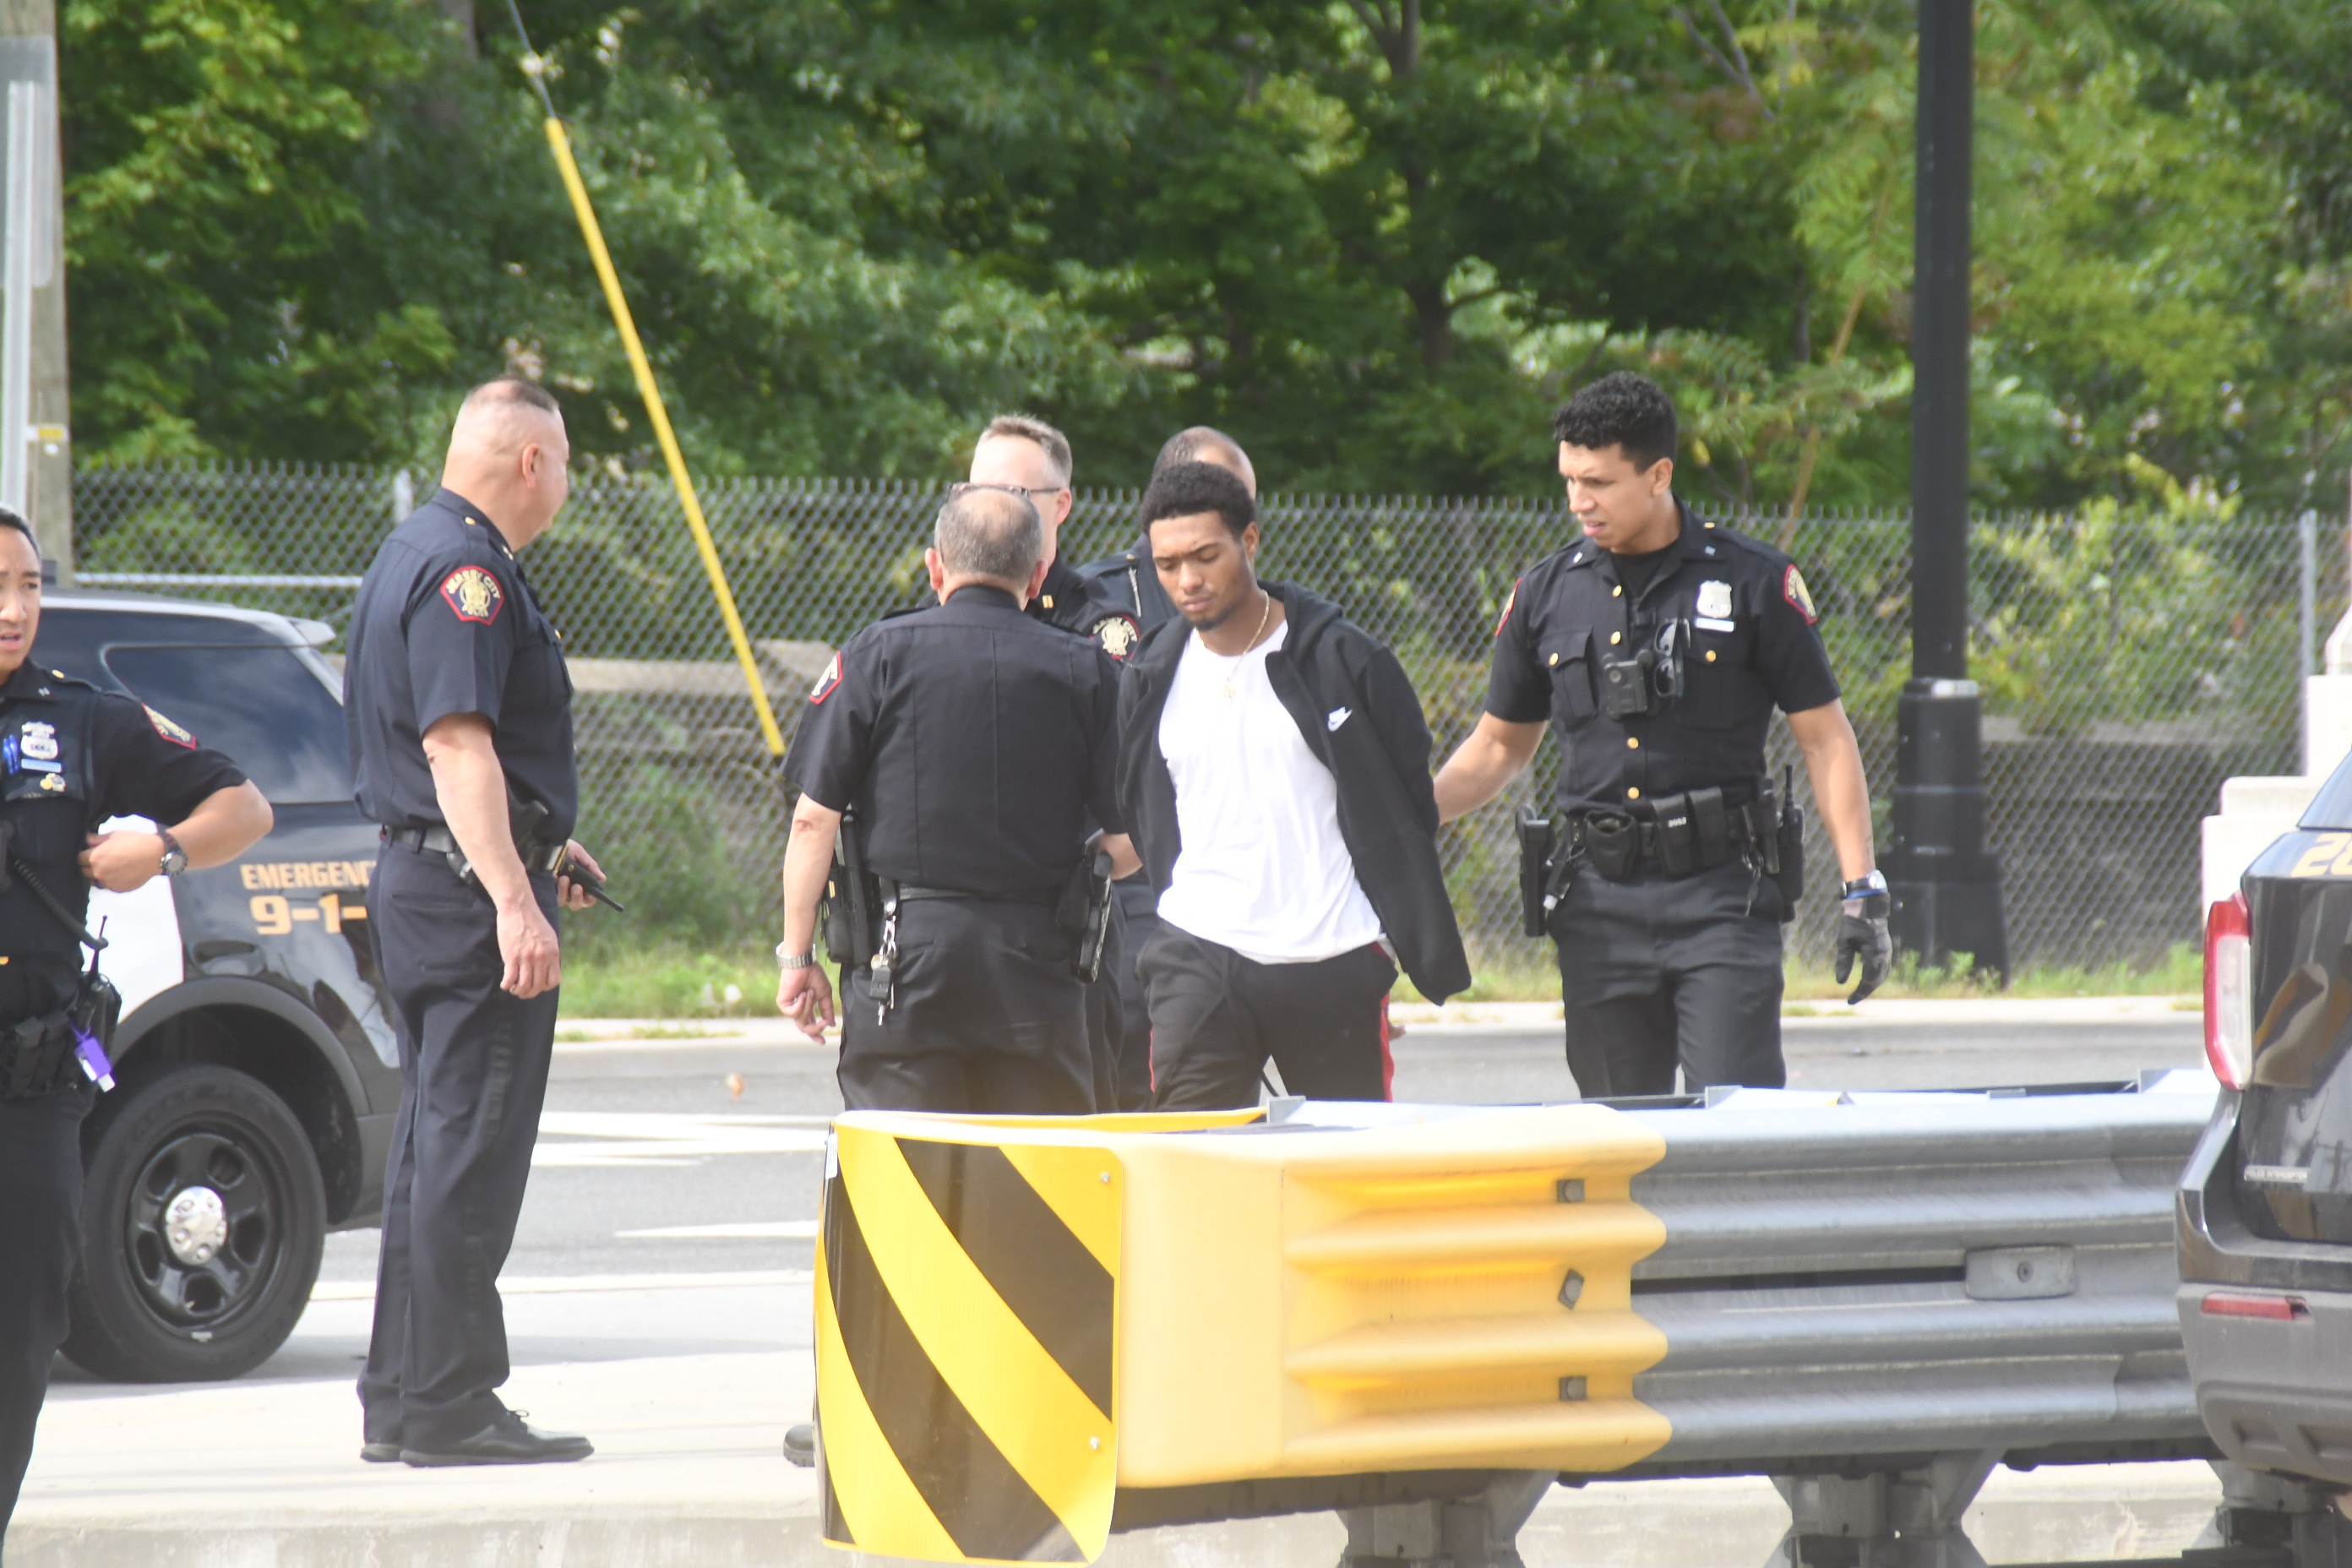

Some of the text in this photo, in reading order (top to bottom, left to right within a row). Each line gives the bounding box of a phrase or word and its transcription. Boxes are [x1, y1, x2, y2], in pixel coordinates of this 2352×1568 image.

[483, 575, 501, 600] CITY
[241, 860, 378, 890] EMERGENC
[249, 892, 368, 935] 9-1-
